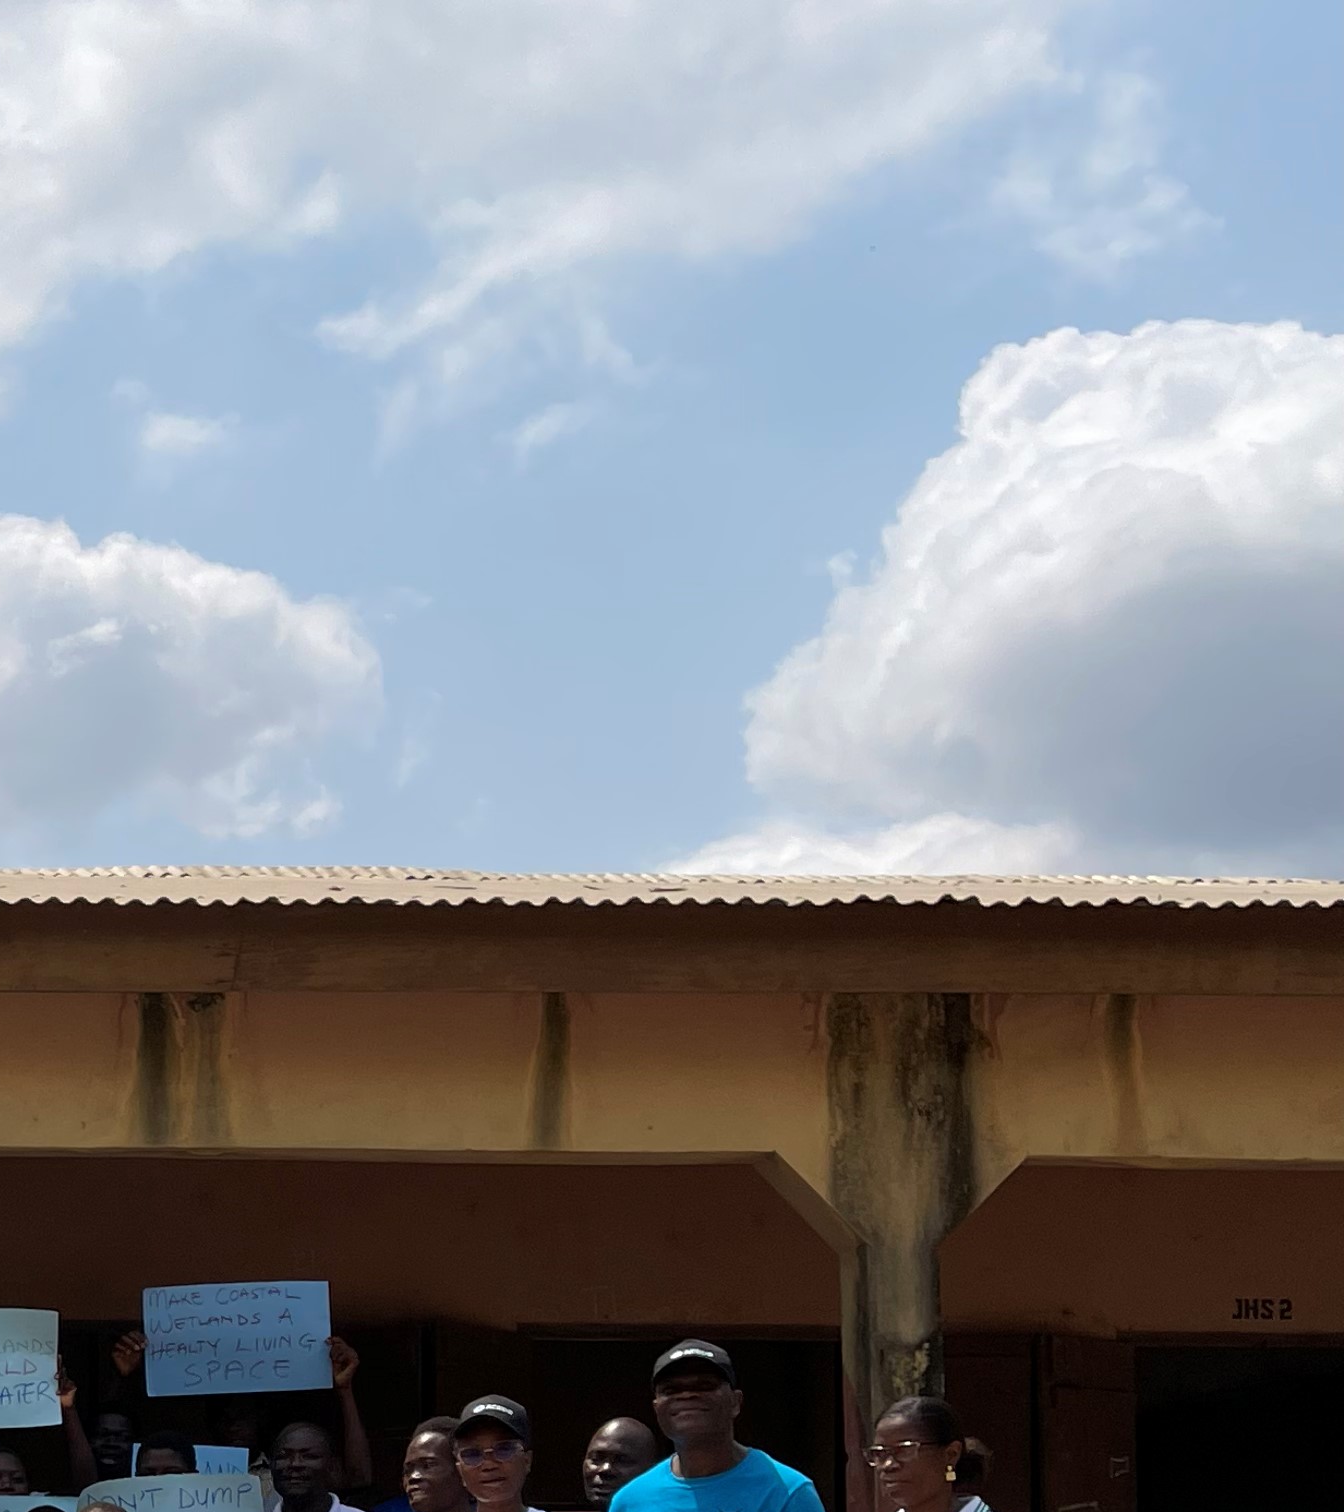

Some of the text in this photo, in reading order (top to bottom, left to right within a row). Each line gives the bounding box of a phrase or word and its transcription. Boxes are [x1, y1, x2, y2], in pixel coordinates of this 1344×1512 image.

[149, 1287, 301, 1308] MAKE COASTAL
[1232, 1298, 1293, 1320] JHS 2
[150, 1308, 294, 1335] WETLANDS A
[235, 1333, 317, 1351] LIVING
[184, 1359, 290, 1388] SPACE
[179, 1483, 253, 1511] DUMP
